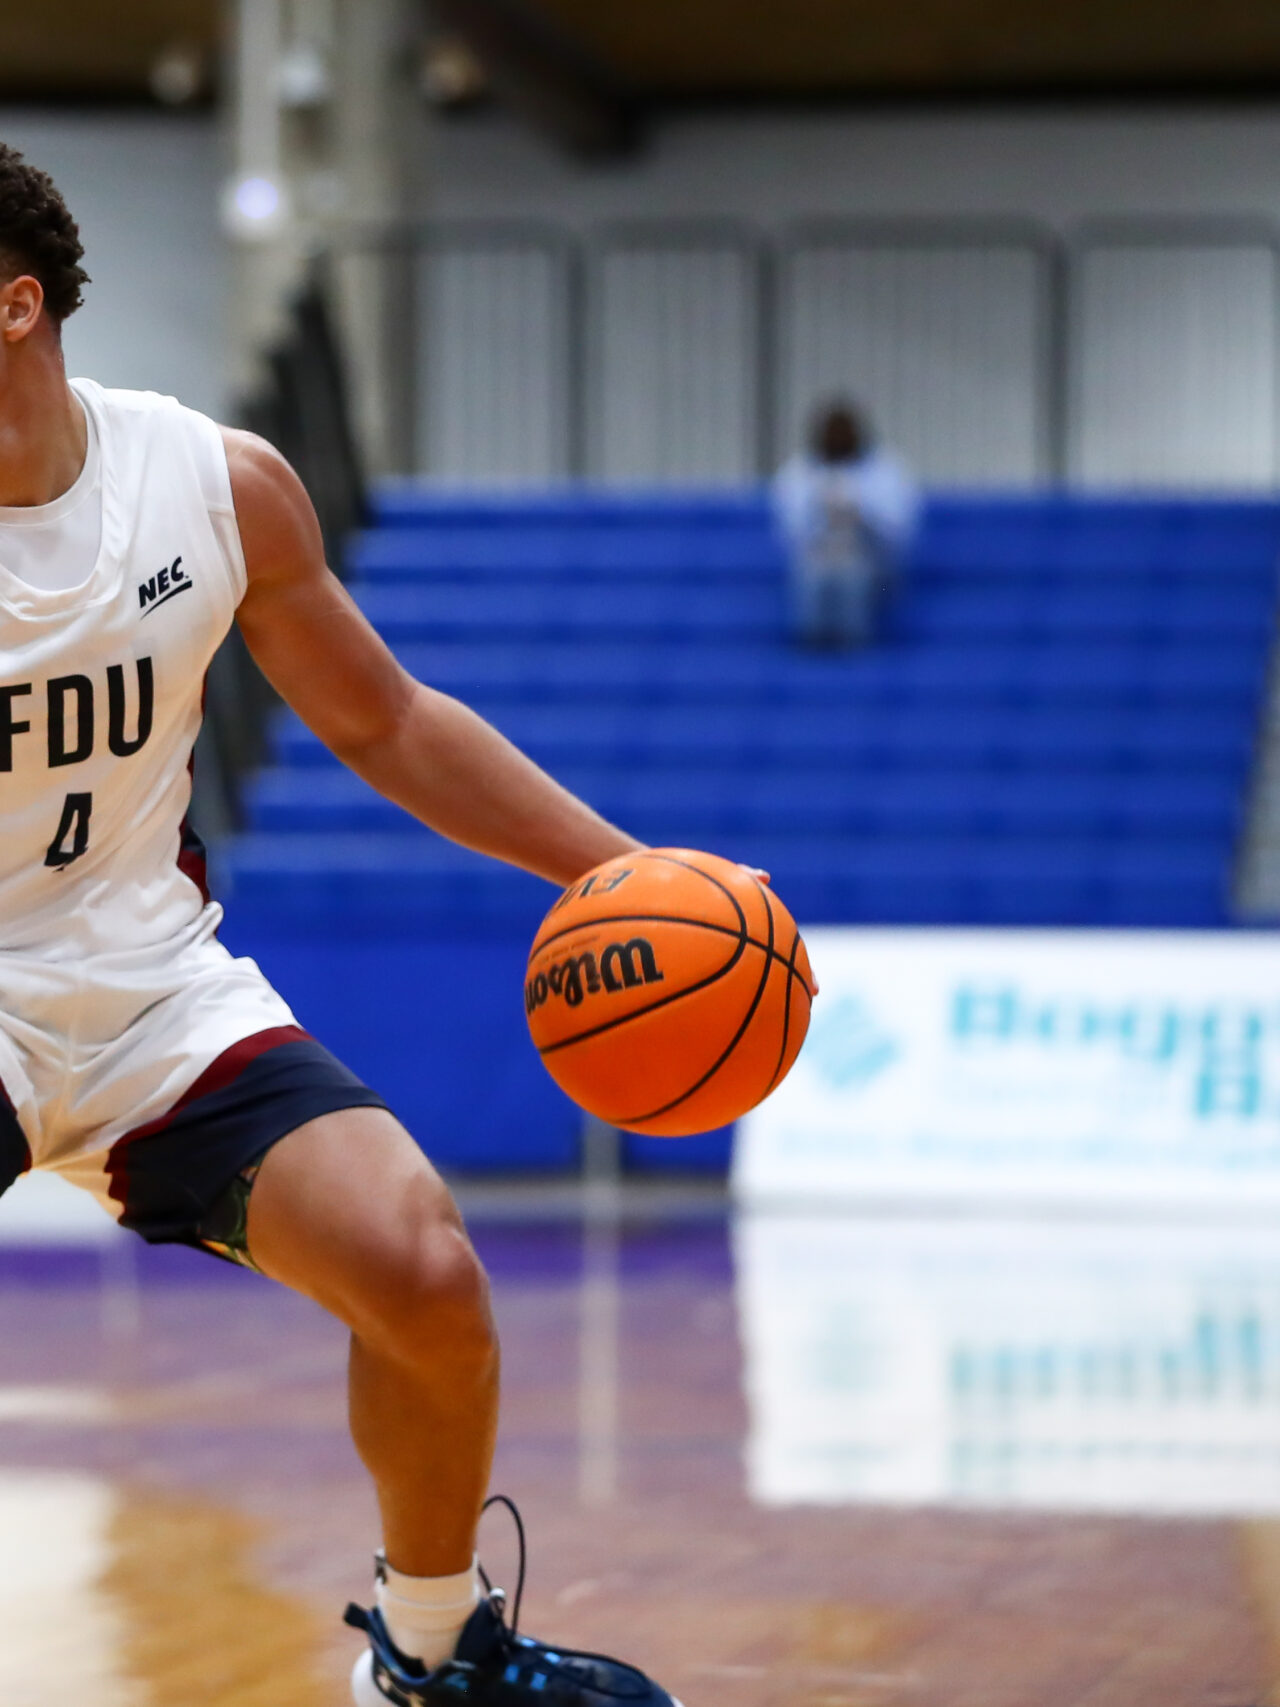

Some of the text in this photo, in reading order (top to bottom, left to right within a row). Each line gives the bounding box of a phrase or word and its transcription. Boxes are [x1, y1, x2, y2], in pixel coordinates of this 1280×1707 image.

[138, 555, 185, 609] NEC
[44, 791, 93, 873] 4
[525, 937, 664, 1016] Wilson
